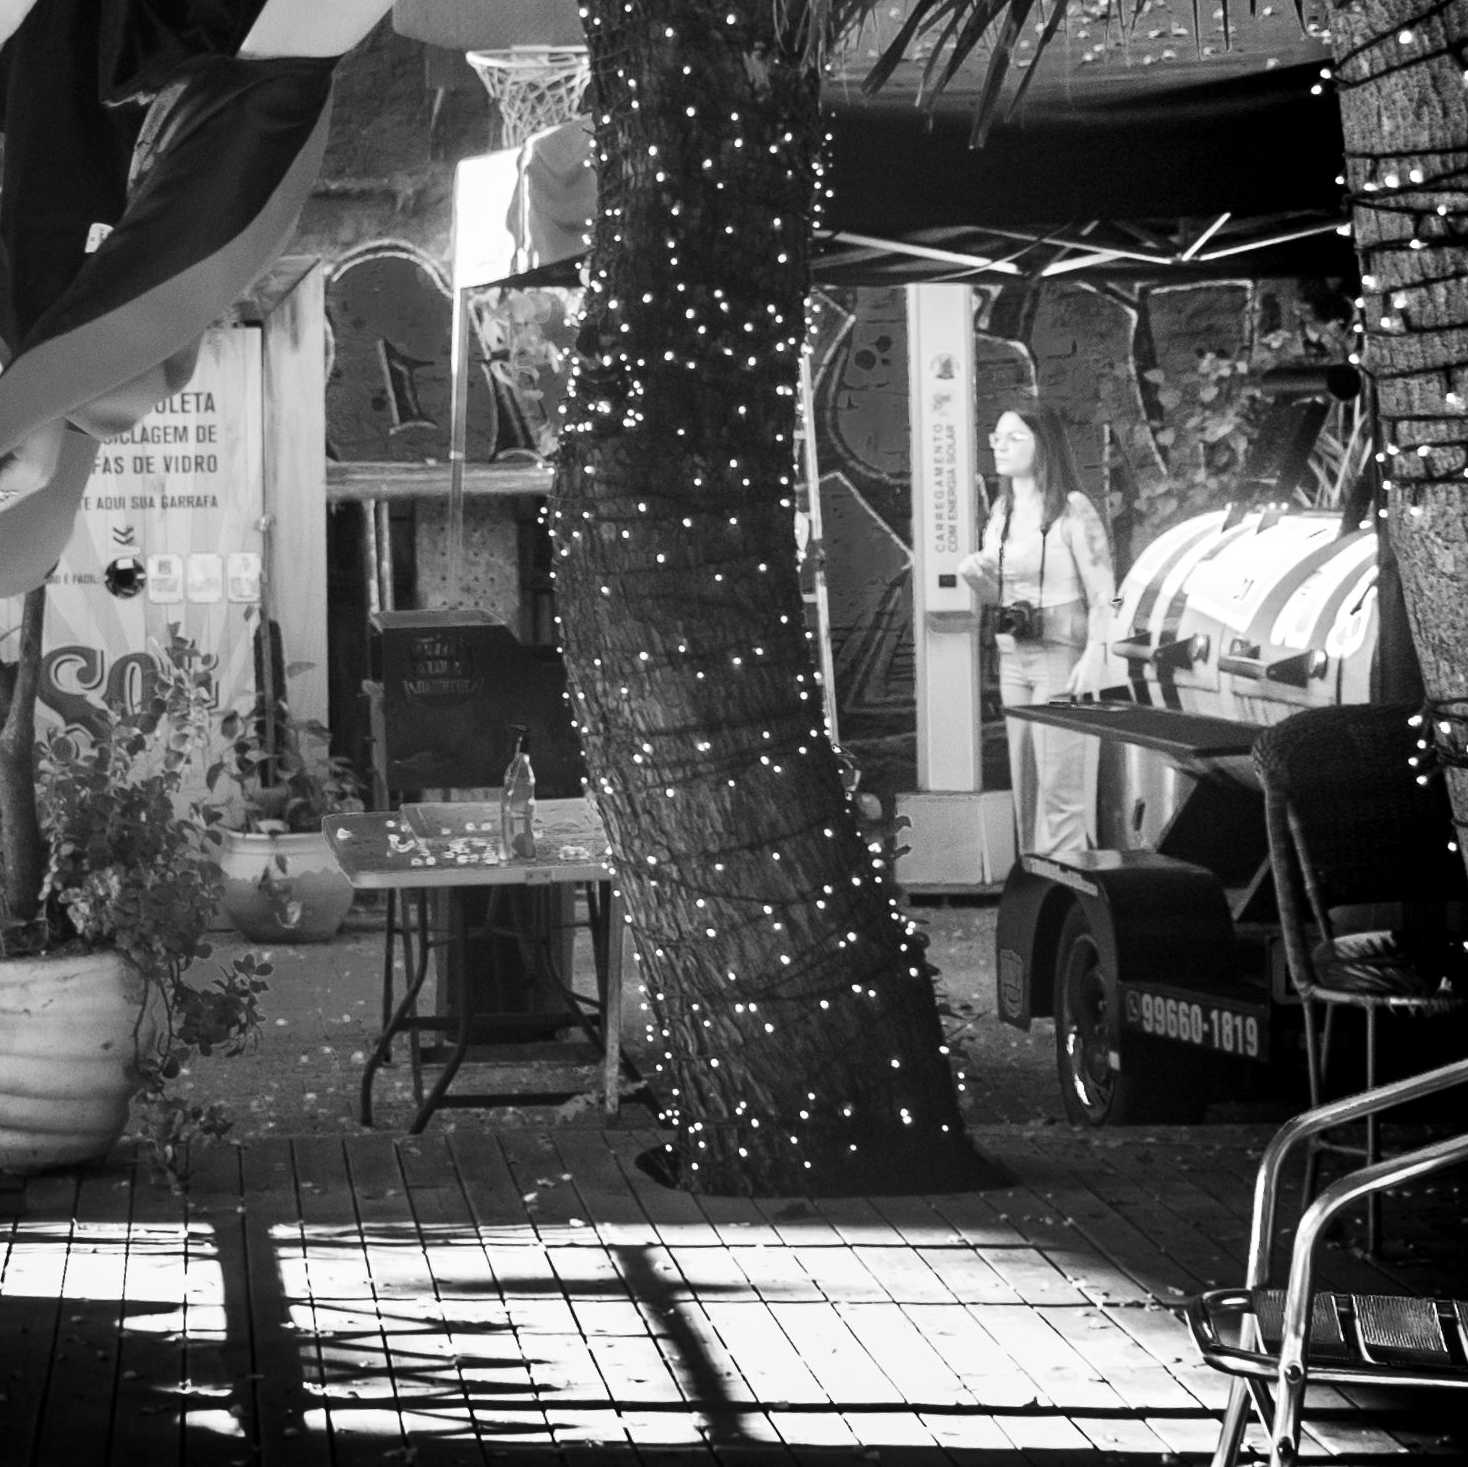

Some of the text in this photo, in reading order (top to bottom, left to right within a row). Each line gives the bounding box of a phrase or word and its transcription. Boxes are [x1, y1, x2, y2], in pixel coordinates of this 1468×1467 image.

[196, 425, 218, 443] DE
[133, 456, 155, 474] DE
[163, 454, 218, 473] VIDRO
[96, 496, 126, 510] AQUI
[131, 495, 155, 509] SUA
[161, 494, 219, 509] GARRAFA
[934, 423, 947, 553] CARREGAMENTO
[946, 424, 959, 553] COM ENERGIA SOLAR
[1141, 993, 1259, 1057] 99660-1819
